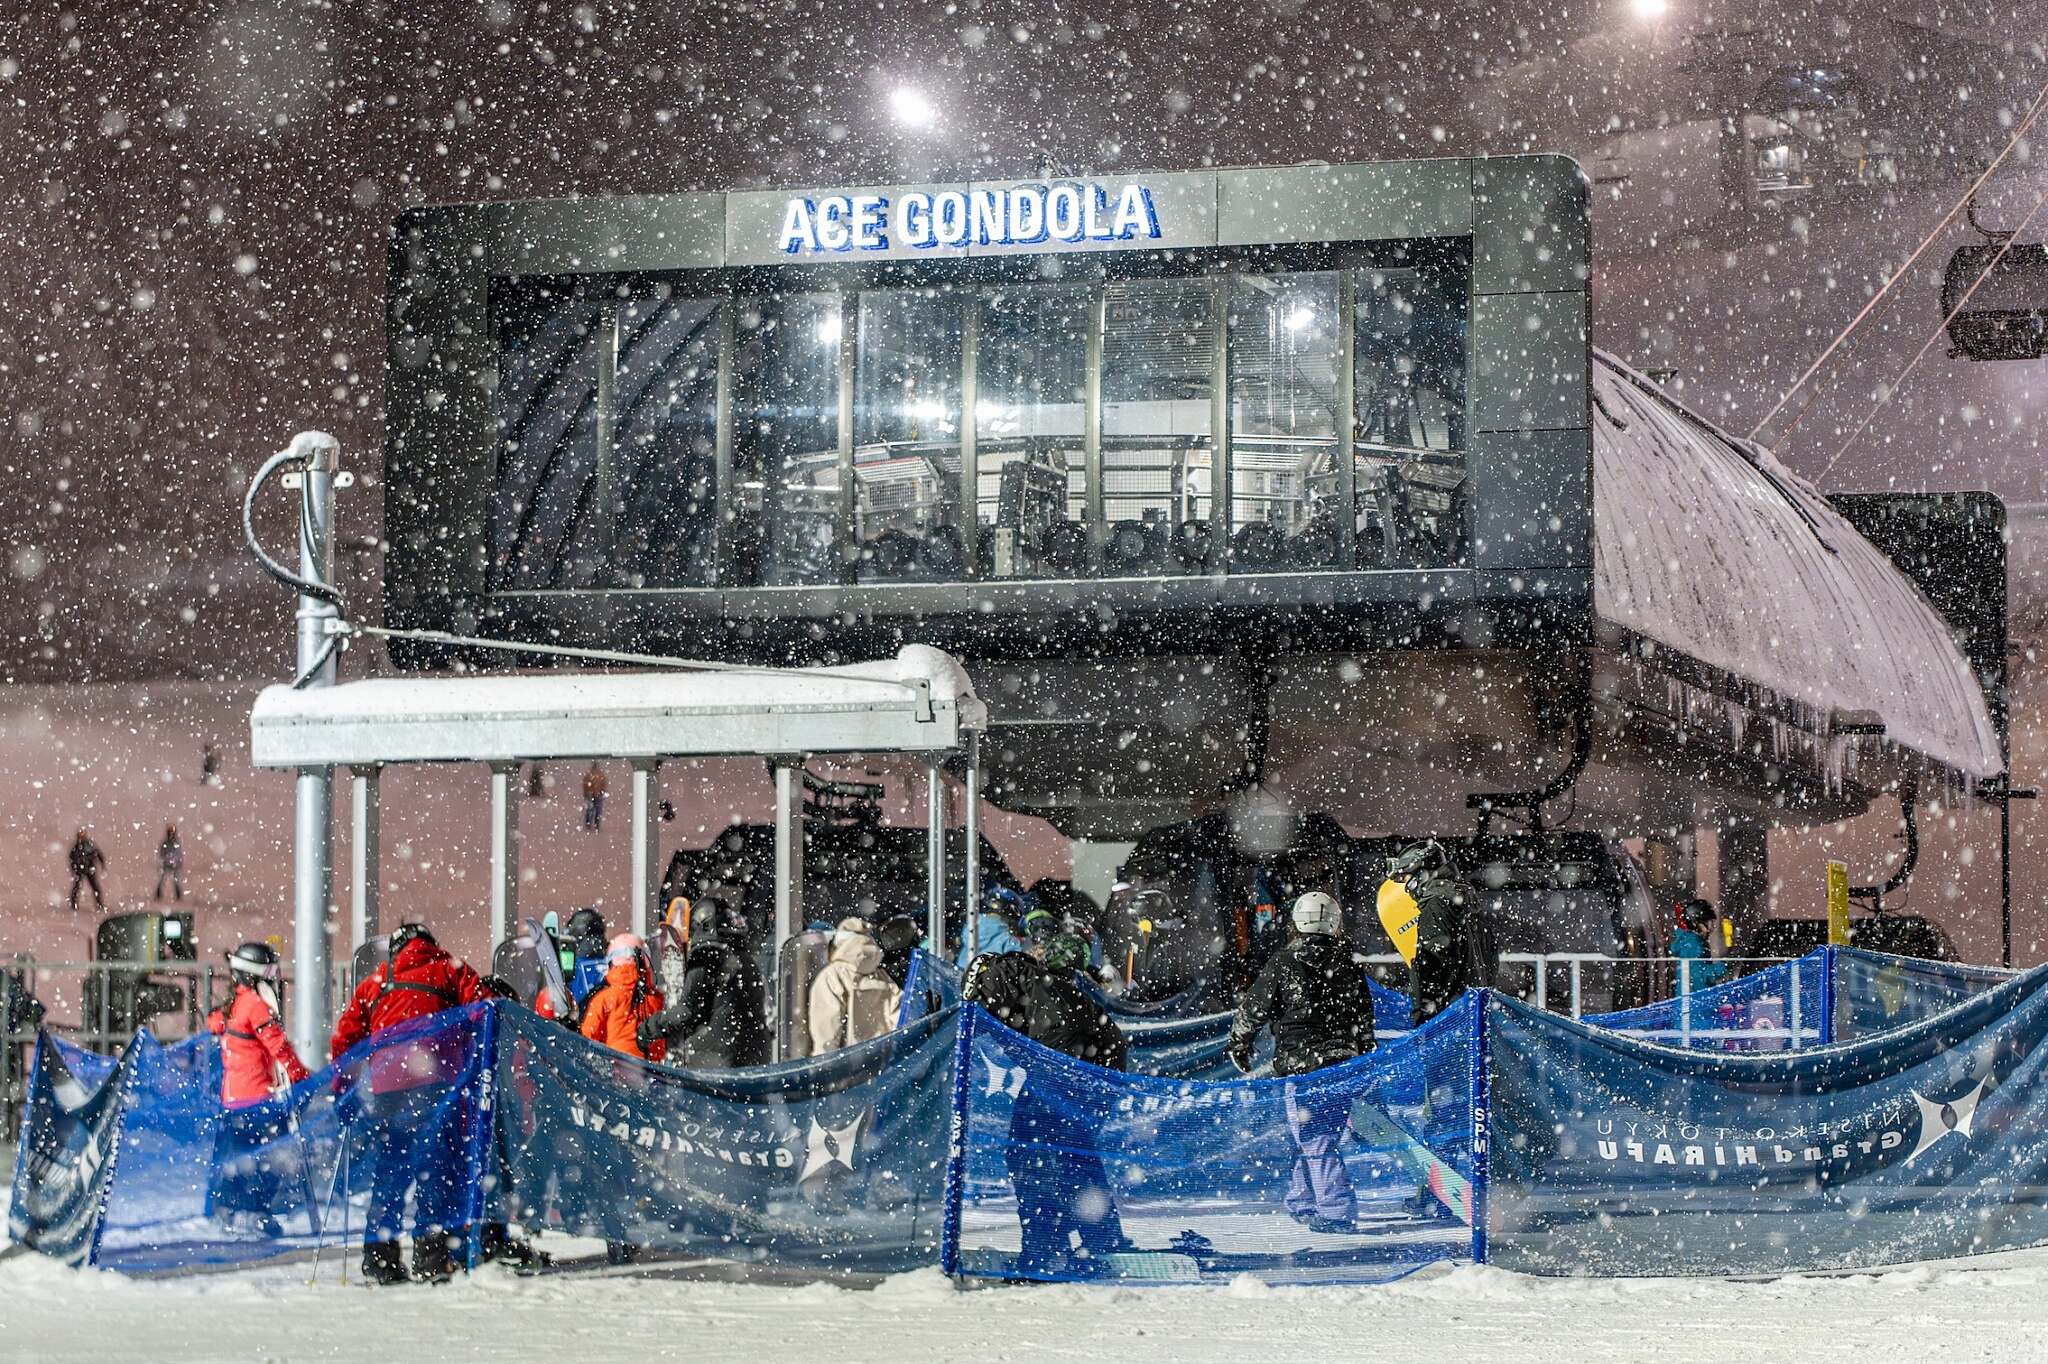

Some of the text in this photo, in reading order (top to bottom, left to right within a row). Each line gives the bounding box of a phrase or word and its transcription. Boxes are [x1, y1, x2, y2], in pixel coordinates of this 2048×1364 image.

[779, 182, 1161, 253] ACE GONDOLA
[481, 1068, 491, 1111] SPM
[951, 1114, 961, 1158] SPM
[1475, 1108, 1485, 1153] SPM
